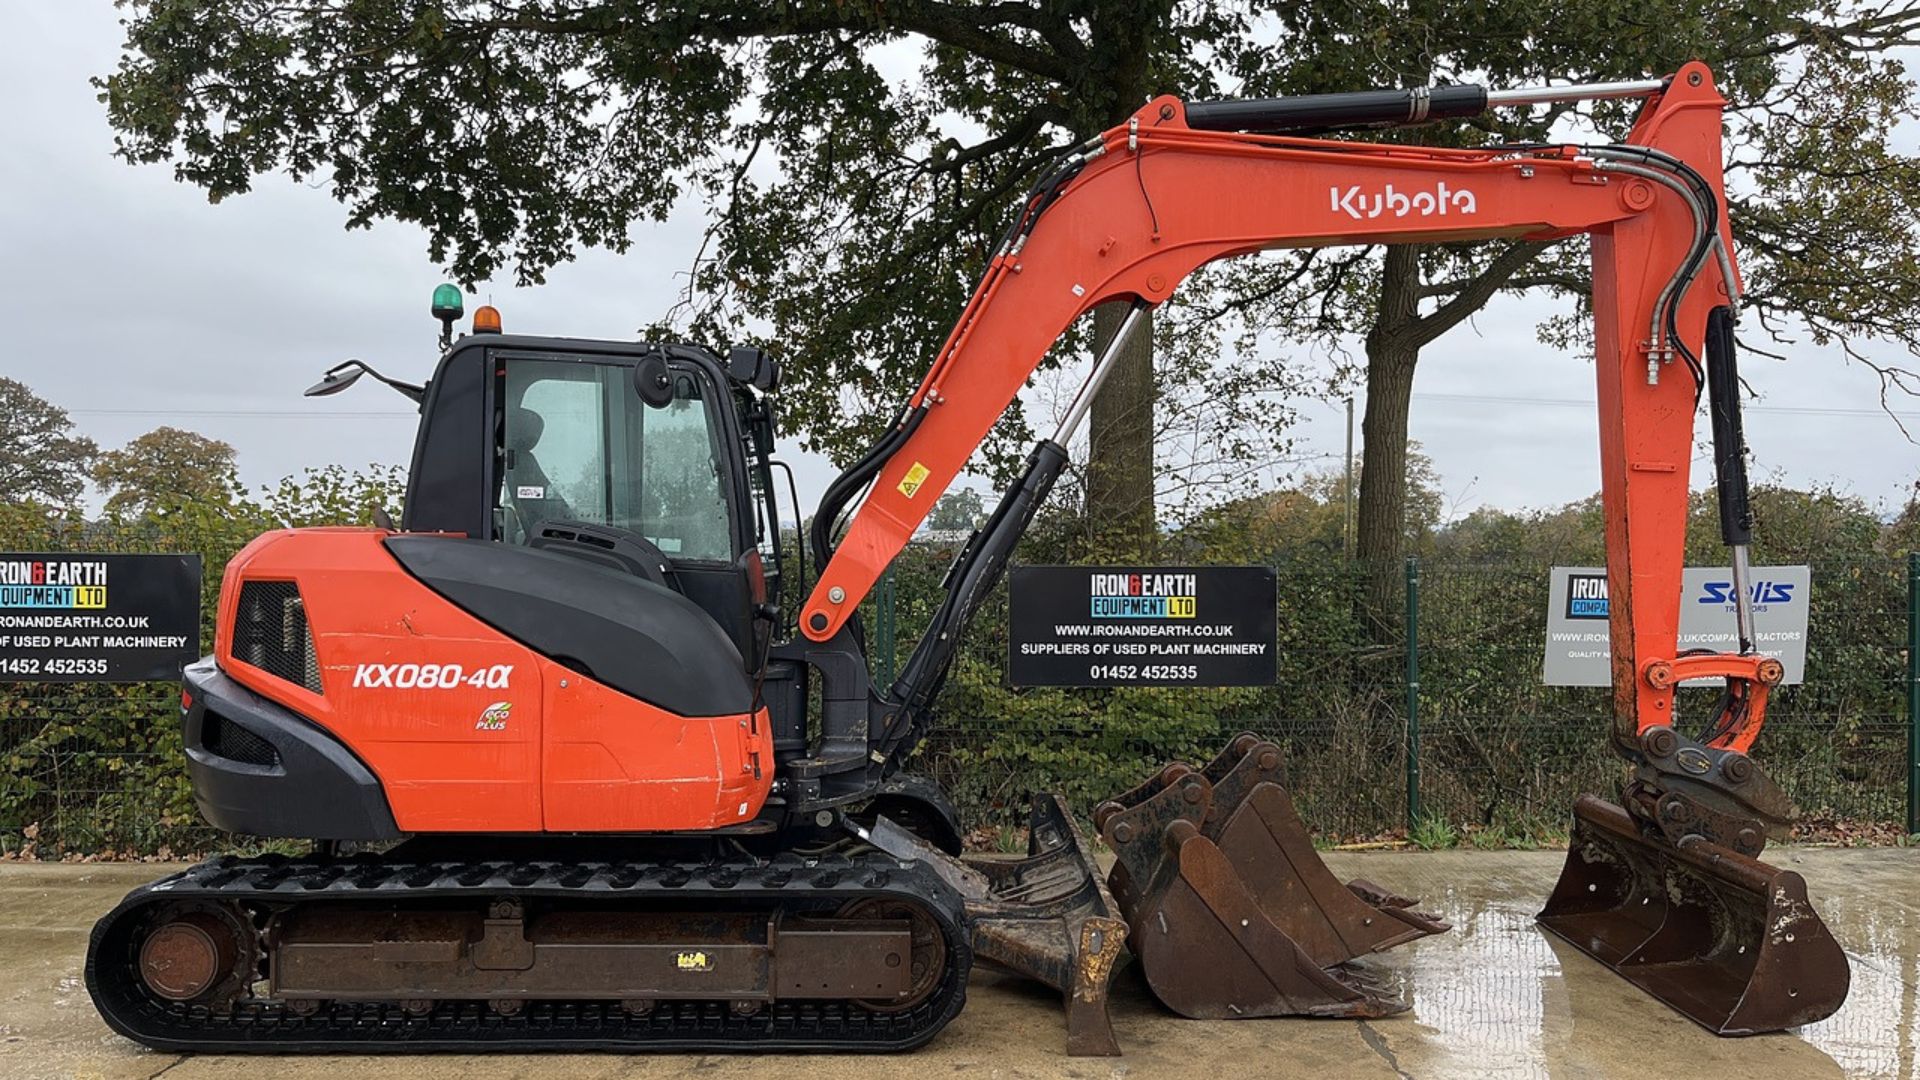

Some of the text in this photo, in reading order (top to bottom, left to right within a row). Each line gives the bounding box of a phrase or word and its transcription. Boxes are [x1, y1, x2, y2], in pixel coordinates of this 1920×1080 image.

[1330, 181, 1476, 219] Kubota
[76, 588, 104, 605] LTD
[1094, 599, 1193, 615] EQUIPMENT LTD
[1573, 601, 1609, 613] COMPA
[1055, 625, 1233, 637] WWW.IRONANDEARTH.CO.UK
[13, 636, 50, 648] USED
[54, 636, 100, 648] PLANT
[103, 636, 187, 648] MACHINERY
[1021, 644, 1266, 655] SUPPLIERS OF USED PLANT MACHINERY
[1568, 650, 1602, 658] QUALITY
[44, 659, 108, 674] 452535
[1090, 665, 1197, 679] 01452 452535
[475, 721, 506, 730] PLUS
